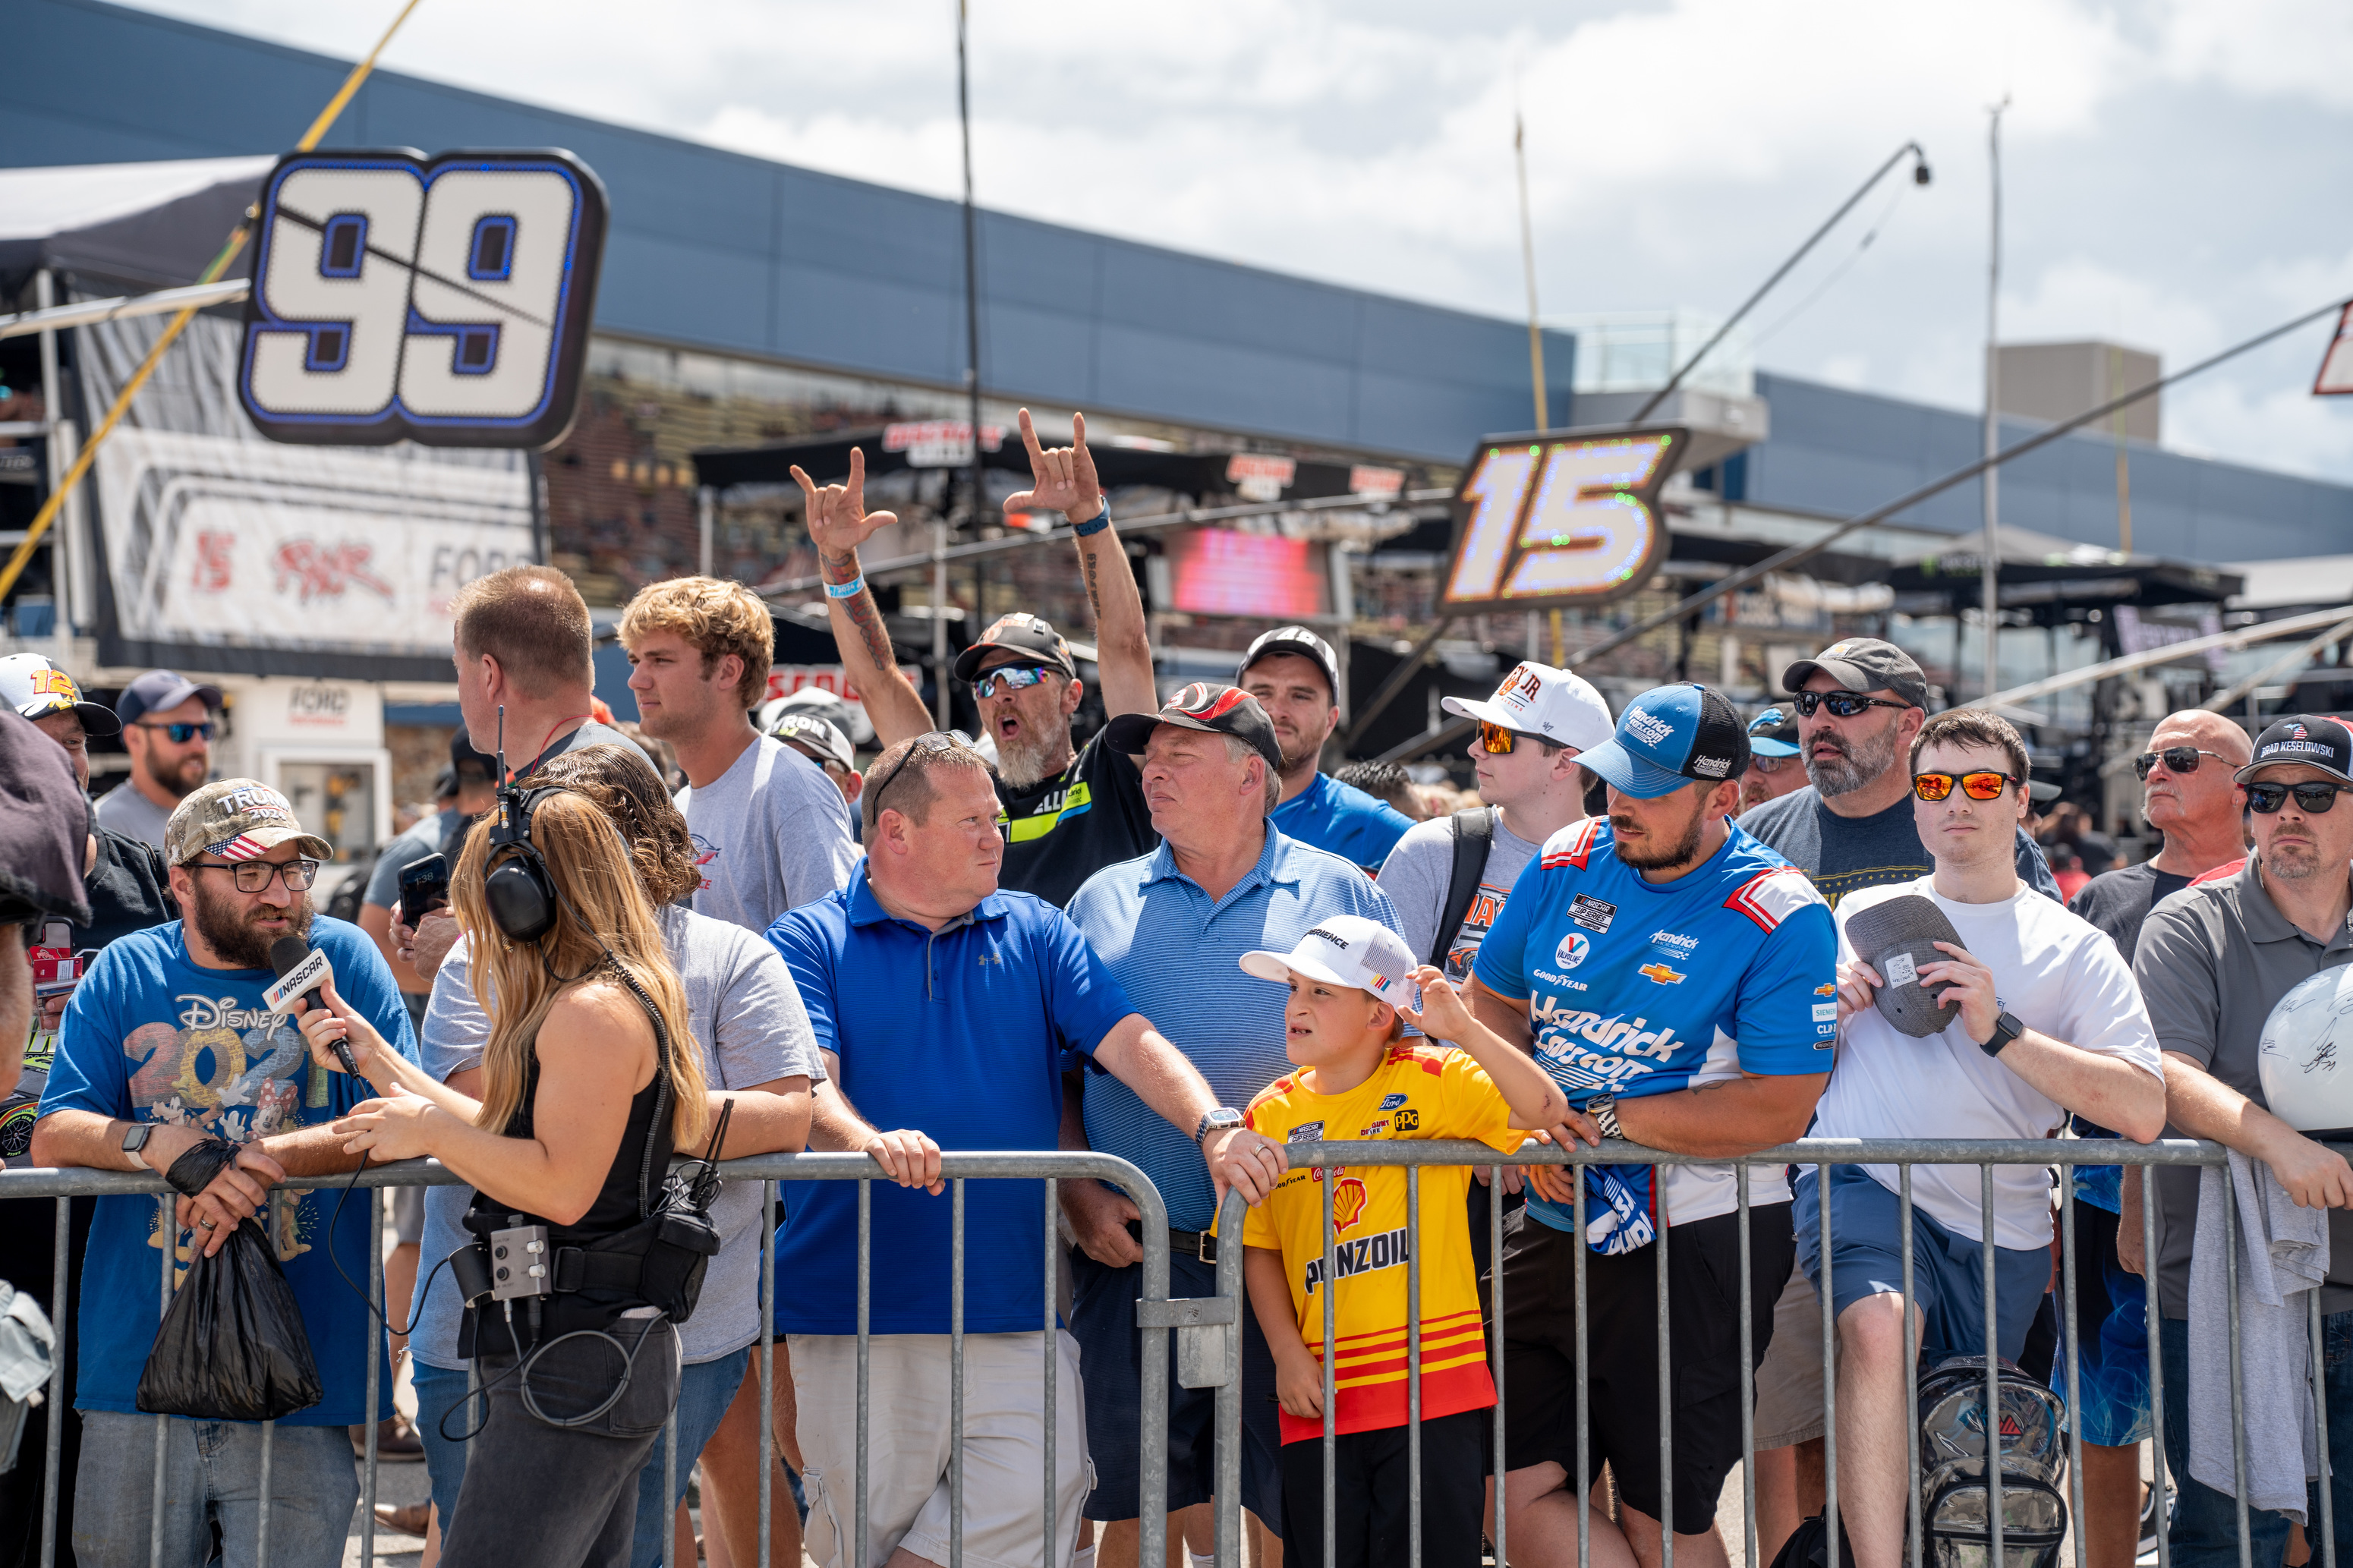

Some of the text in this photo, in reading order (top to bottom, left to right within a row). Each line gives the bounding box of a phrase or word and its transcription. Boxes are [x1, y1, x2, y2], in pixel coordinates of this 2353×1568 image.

[249, 164, 578, 422] 99
[1446, 434, 1671, 601] 15
[30, 669, 74, 697] 12
[767, 714, 827, 739] YRON
[1628, 705, 1675, 737] Hendrick
[2260, 741, 2335, 758] BRAD KESELOWSKI
[1693, 754, 1732, 770] Hendrick
[414, 871, 434, 886] 1:38
[1574, 906, 1607, 923] CUP SERIES
[1585, 899, 1611, 913] NASCAR
[1580, 921, 1602, 930] CHAMPION
[1649, 929, 1699, 949] Hendrick
[1557, 948, 1582, 965] VALVOLINE
[282, 956, 324, 997] NASCAR
[1530, 989, 1685, 1063] Hendrick
[1380, 1096, 1402, 1108] Ford
[1299, 1124, 1319, 1134] NASCAR
[1395, 1111, 1418, 1130] PPG
[1292, 1132, 1319, 1142] CUP SERIES
[1305, 1227, 1410, 1295] PNZOIL
